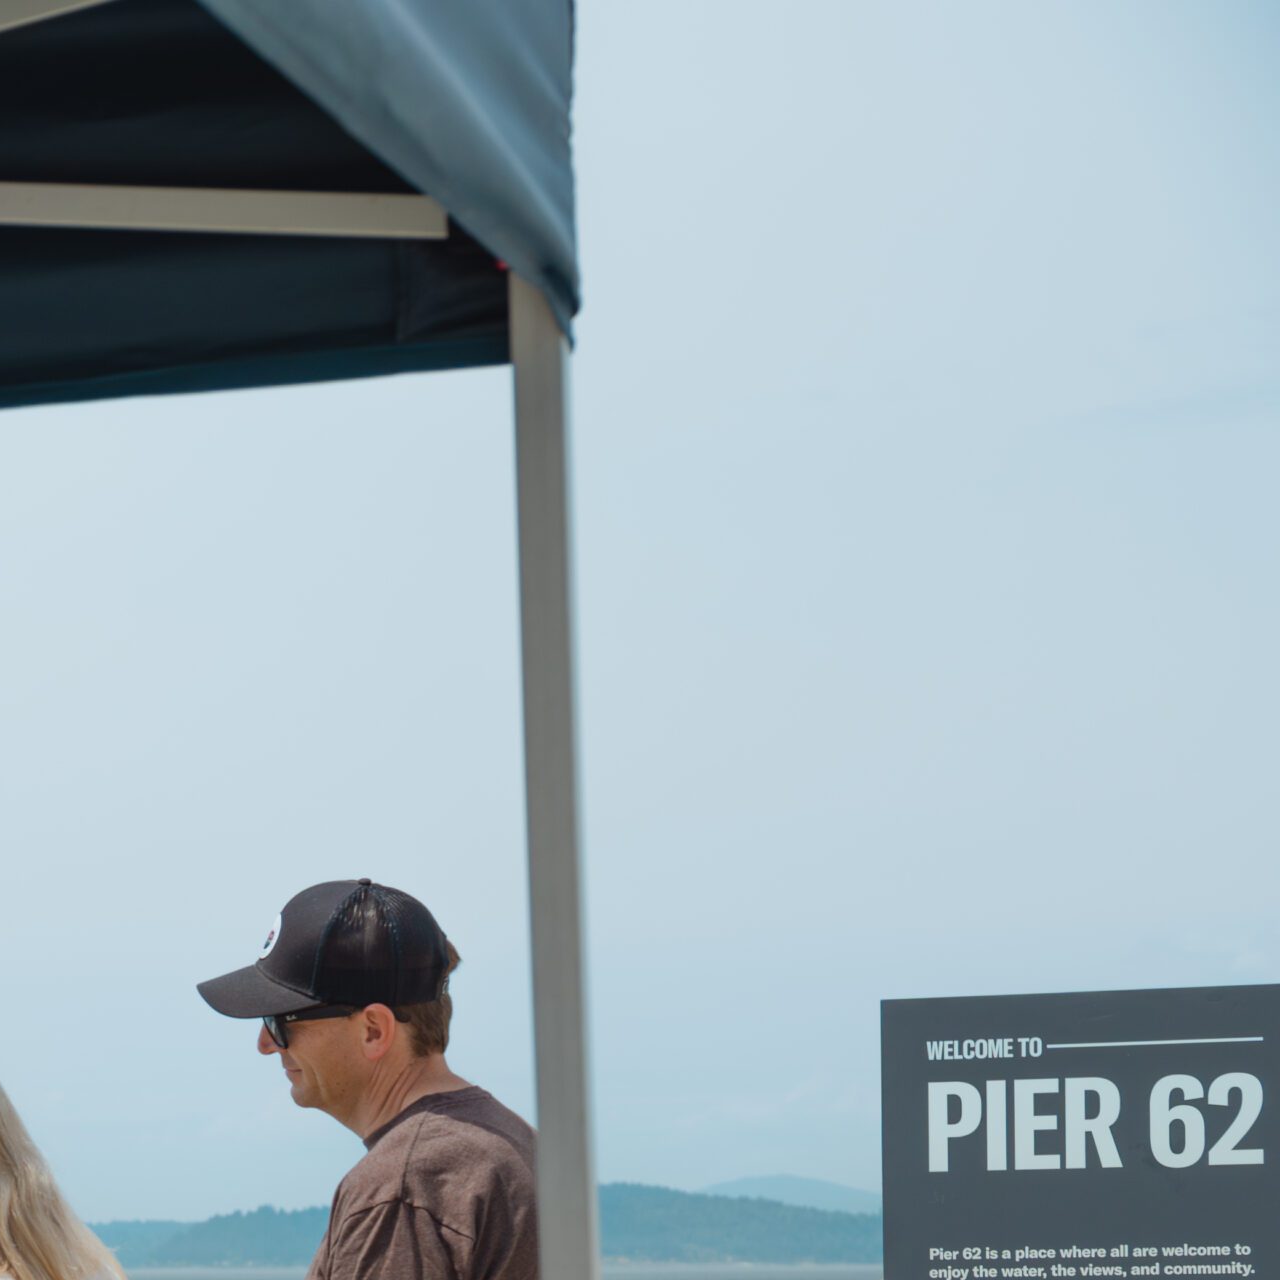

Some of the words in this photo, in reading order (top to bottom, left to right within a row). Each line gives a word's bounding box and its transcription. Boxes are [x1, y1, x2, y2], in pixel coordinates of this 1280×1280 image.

[927, 1038, 1014, 1061] WELCOME
[1018, 1037, 1042, 1059] TO
[928, 1076, 1124, 1173] PIER
[1149, 1072, 1265, 1169] 62
[929, 1247, 959, 1261] Pier
[962, 1247, 982, 1260] 62
[985, 1247, 998, 1260] is
[1001, 1250, 1011, 1259] a
[1015, 1246, 1056, 1262] place
[1059, 1245, 1107, 1258] where
[1110, 1244, 1128, 1258] all
[1132, 1247, 1158, 1258] are
[1162, 1243, 1231, 1257] welcome
[1234, 1243, 1251, 1256] to
[972, 1265, 998, 1278] the
[1001, 1265, 1047, 1279] water,
[1050, 1264, 1076, 1277] the
[1080, 1263, 1127, 1278] views,
[1131, 1262, 1160, 1276] and
[1164, 1261, 1255, 1278] community.
